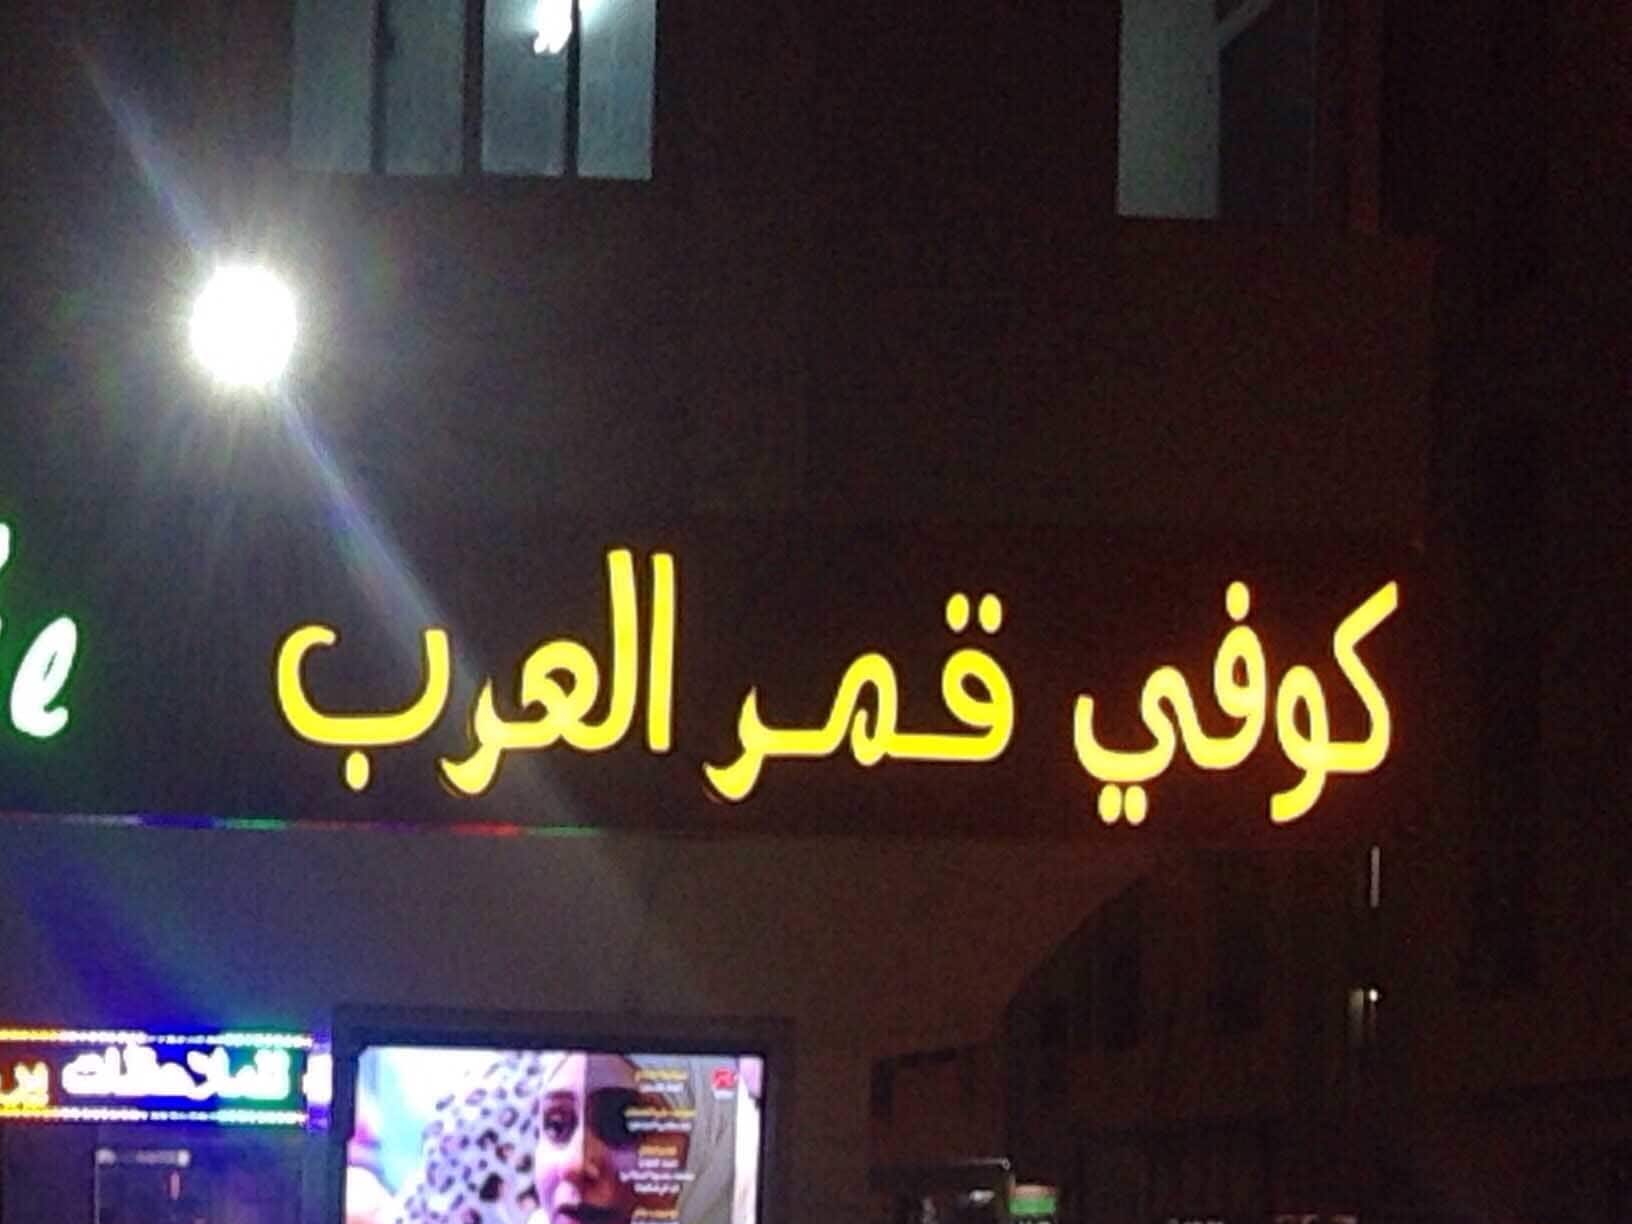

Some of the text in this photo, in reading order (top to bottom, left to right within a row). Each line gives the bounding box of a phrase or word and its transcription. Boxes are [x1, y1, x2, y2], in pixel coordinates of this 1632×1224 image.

[278, 550, 1397, 824] كوفي قمر العرب
